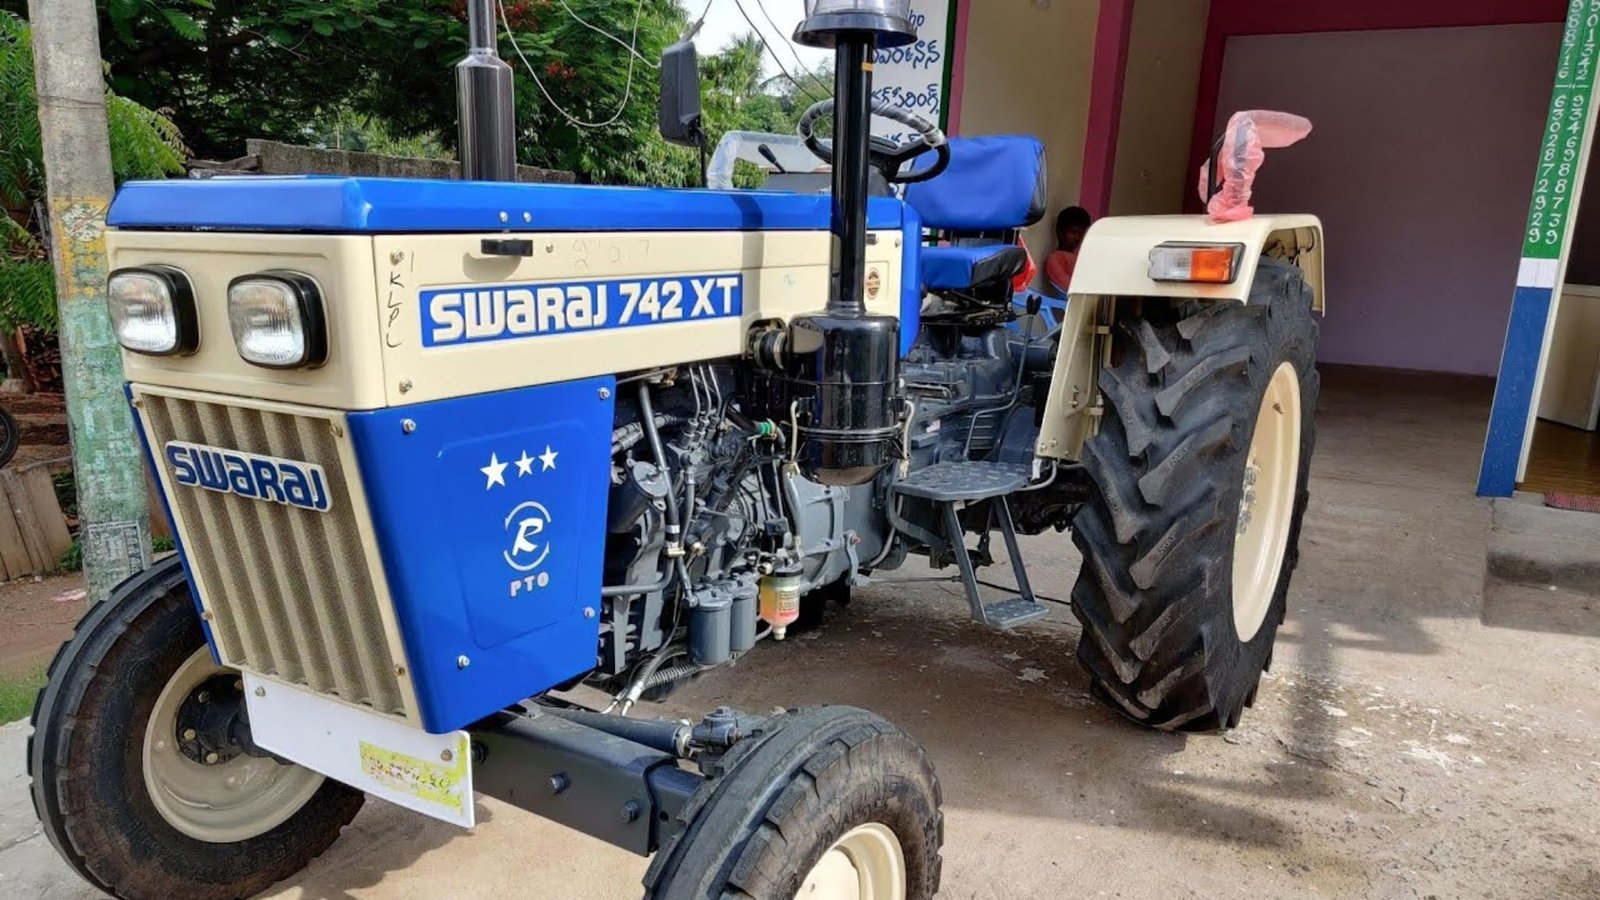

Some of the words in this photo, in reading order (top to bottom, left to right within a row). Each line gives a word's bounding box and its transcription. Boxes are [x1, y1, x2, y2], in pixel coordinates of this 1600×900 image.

[1528, 94, 1567, 243] 6302872929
[1545, 94, 1584, 245] 9346988739
[619, 280, 684, 325] 742
[690, 277, 739, 317] XT
[510, 571, 550, 598] PTO
